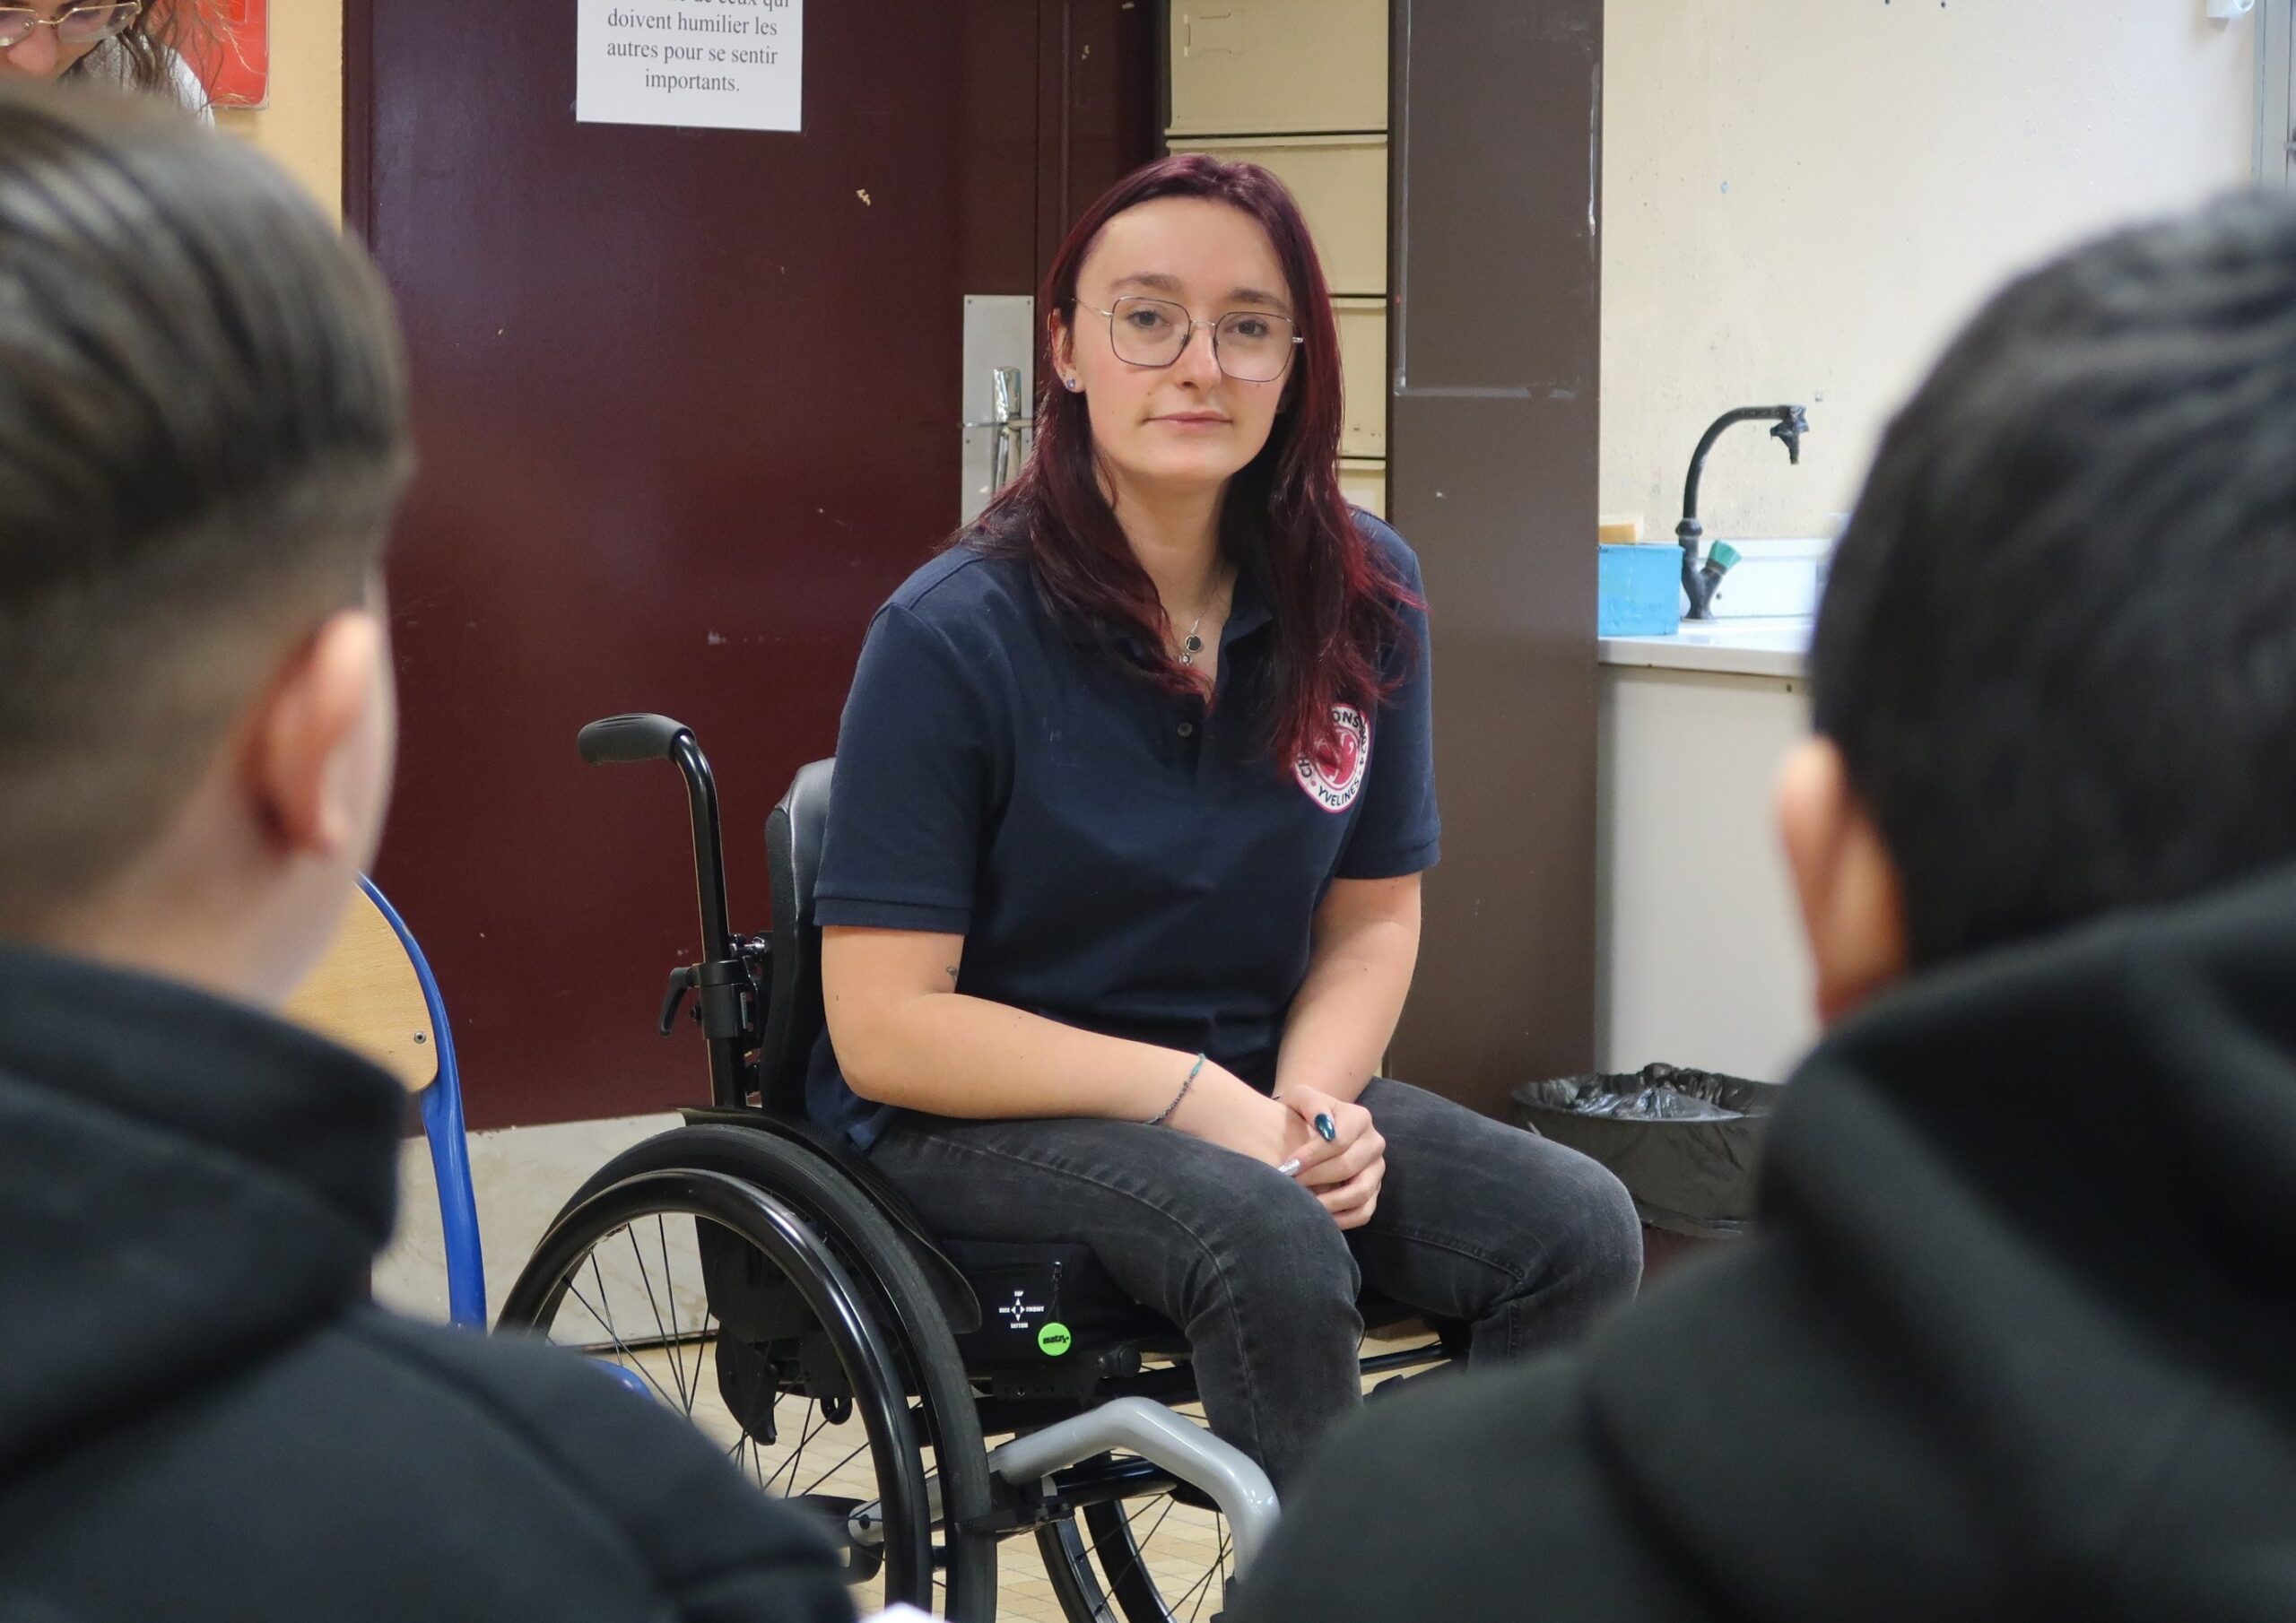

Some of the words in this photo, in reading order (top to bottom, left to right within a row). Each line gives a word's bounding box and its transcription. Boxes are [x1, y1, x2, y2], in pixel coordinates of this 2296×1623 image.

[608, 8, 671, 29] doivent
[678, 12, 749, 33] humilier
[755, 17, 777, 35] les
[607, 42, 657, 57] autres
[665, 47, 703, 64] pour
[709, 49, 726, 61] se
[732, 46, 778, 64] sentir
[646, 69, 739, 93] importants.
[1318, 778, 1360, 806] YVELINES
